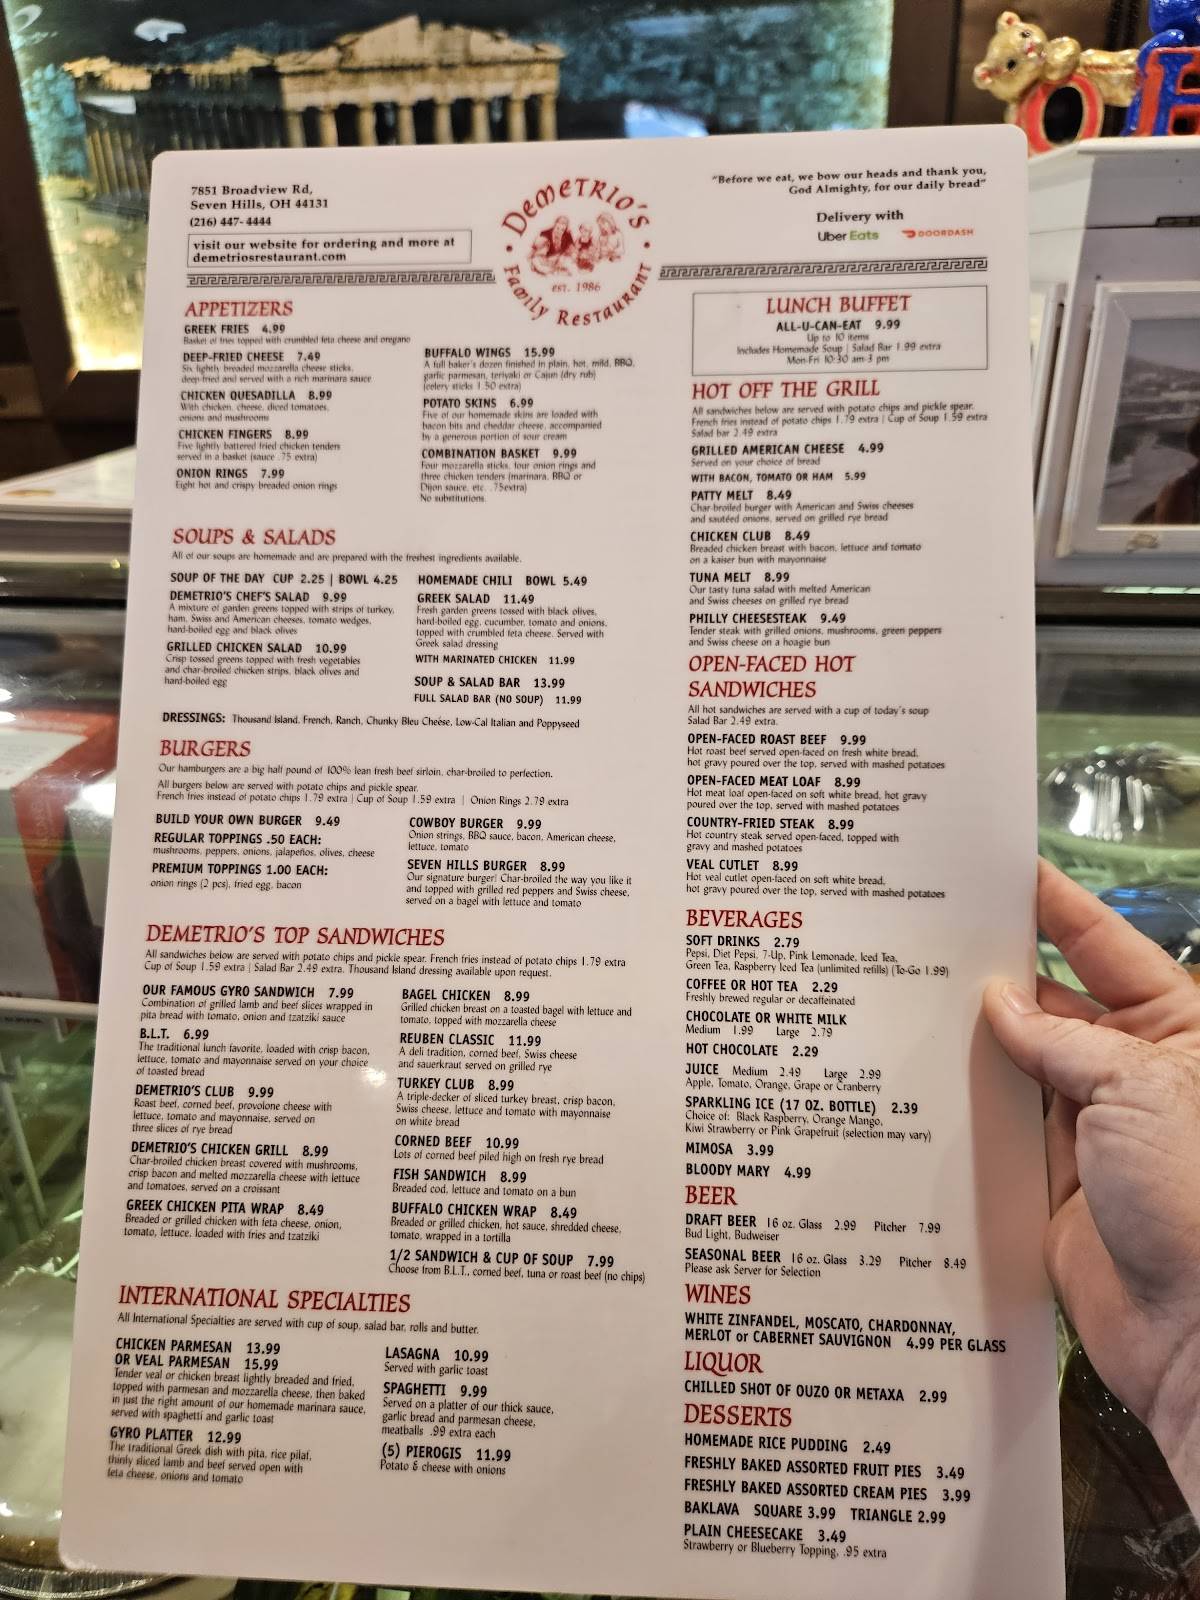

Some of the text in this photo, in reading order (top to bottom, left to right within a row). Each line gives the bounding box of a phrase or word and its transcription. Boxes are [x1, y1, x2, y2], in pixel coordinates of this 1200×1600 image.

[776, 174, 794, 182] eat,
[817, 172, 840, 180] bow
[866, 169, 898, 178] heads
[902, 168, 922, 177] and
[926, 167, 959, 176] thank
[963, 169, 986, 177] you,
[192, 184, 312, 195] 7851 Broadview Rd,
[191, 199, 327, 210] Seven Hills, OH 44131
[817, 210, 903, 224] Delivery with
[818, 229, 974, 241] Uber Eats DOORDASH
[193, 240, 220, 250] visit
[250, 240, 297, 249] website
[302, 239, 319, 249] for
[323, 238, 377, 251] ordering
[381, 237, 403, 247] and
[444, 238, 454, 246] at
[193, 252, 346, 262] demetriosrestaurant.com
[184, 300, 293, 317] APPETIZERS
[767, 295, 912, 314] LUNCH BUFFET
[183, 324, 285, 335] GREEK FRIES 4.99
[776, 319, 900, 332] ALL-U-CAN-EAT 9.99
[425, 347, 555, 358] BUFFALO WINGS 15.99
[692, 380, 880, 399] HOT OFF THE GRILL
[173, 528, 335, 545] SOUPS & SALADS
[689, 656, 856, 673] OPEN-FACED HOT
[688, 681, 817, 698] SANDWICHES
[160, 740, 251, 757] BURGERS
[156, 814, 340, 826] BUILD YOUR OWN BURGER 9.49
[687, 817, 854, 830] COUNTRY-FRIED STEAK 8.99
[686, 909, 802, 928] BEVERAGES
[143, 984, 353, 998] OUR FAMOUS GYRO SANDWICH 7.99
[140, 1028, 209, 1040] B.L.T. 6.99
[686, 1096, 918, 1114] SPARKLING ICE (17 OZ. BOTTLE) 2.39
[394, 1149, 411, 1158] Lots
[414, 1149, 423, 1159] of
[426, 1150, 455, 1160] corned
[458, 1150, 476, 1160] beef
[479, 1151, 499, 1163] piled
[502, 1152, 521, 1165] high
[539, 1152, 559, 1163] fresh
[563, 1156, 576, 1166] rye
[580, 1153, 603, 1164] bread
[685, 1185, 738, 1205] BEER
[686, 1213, 723, 1226] DRAFT
[728, 1215, 756, 1227] BEER
[768, 1218, 778, 1228] 16
[799, 1219, 822, 1229] Glass
[834, 1220, 856, 1231] 2.99
[875, 1221, 906, 1232] Pitcher
[919, 1223, 940, 1234] 7.99
[390, 1249, 614, 1268] 1/2 SANDWICH & CUP OF SOUP 7.99
[118, 1285, 410, 1313] INTERNATIONAL SPECIALTIES
[685, 1283, 751, 1304] WINES
[685, 1328, 1006, 1352] MERLOT or CABERNET SAUVIGNON 4.99 PER GLASS
[684, 1351, 763, 1377] LIQUOR
[684, 1403, 792, 1427] DESSERTS
[381, 1442, 511, 1462] (5) PIEROGIS 11.99
[685, 1501, 945, 1524] BAKLAVA SQUARE 3.99 TRIANGLE 2.99
[684, 1537, 886, 1559] Strawberry or Blueberry Topping, .95 extra
